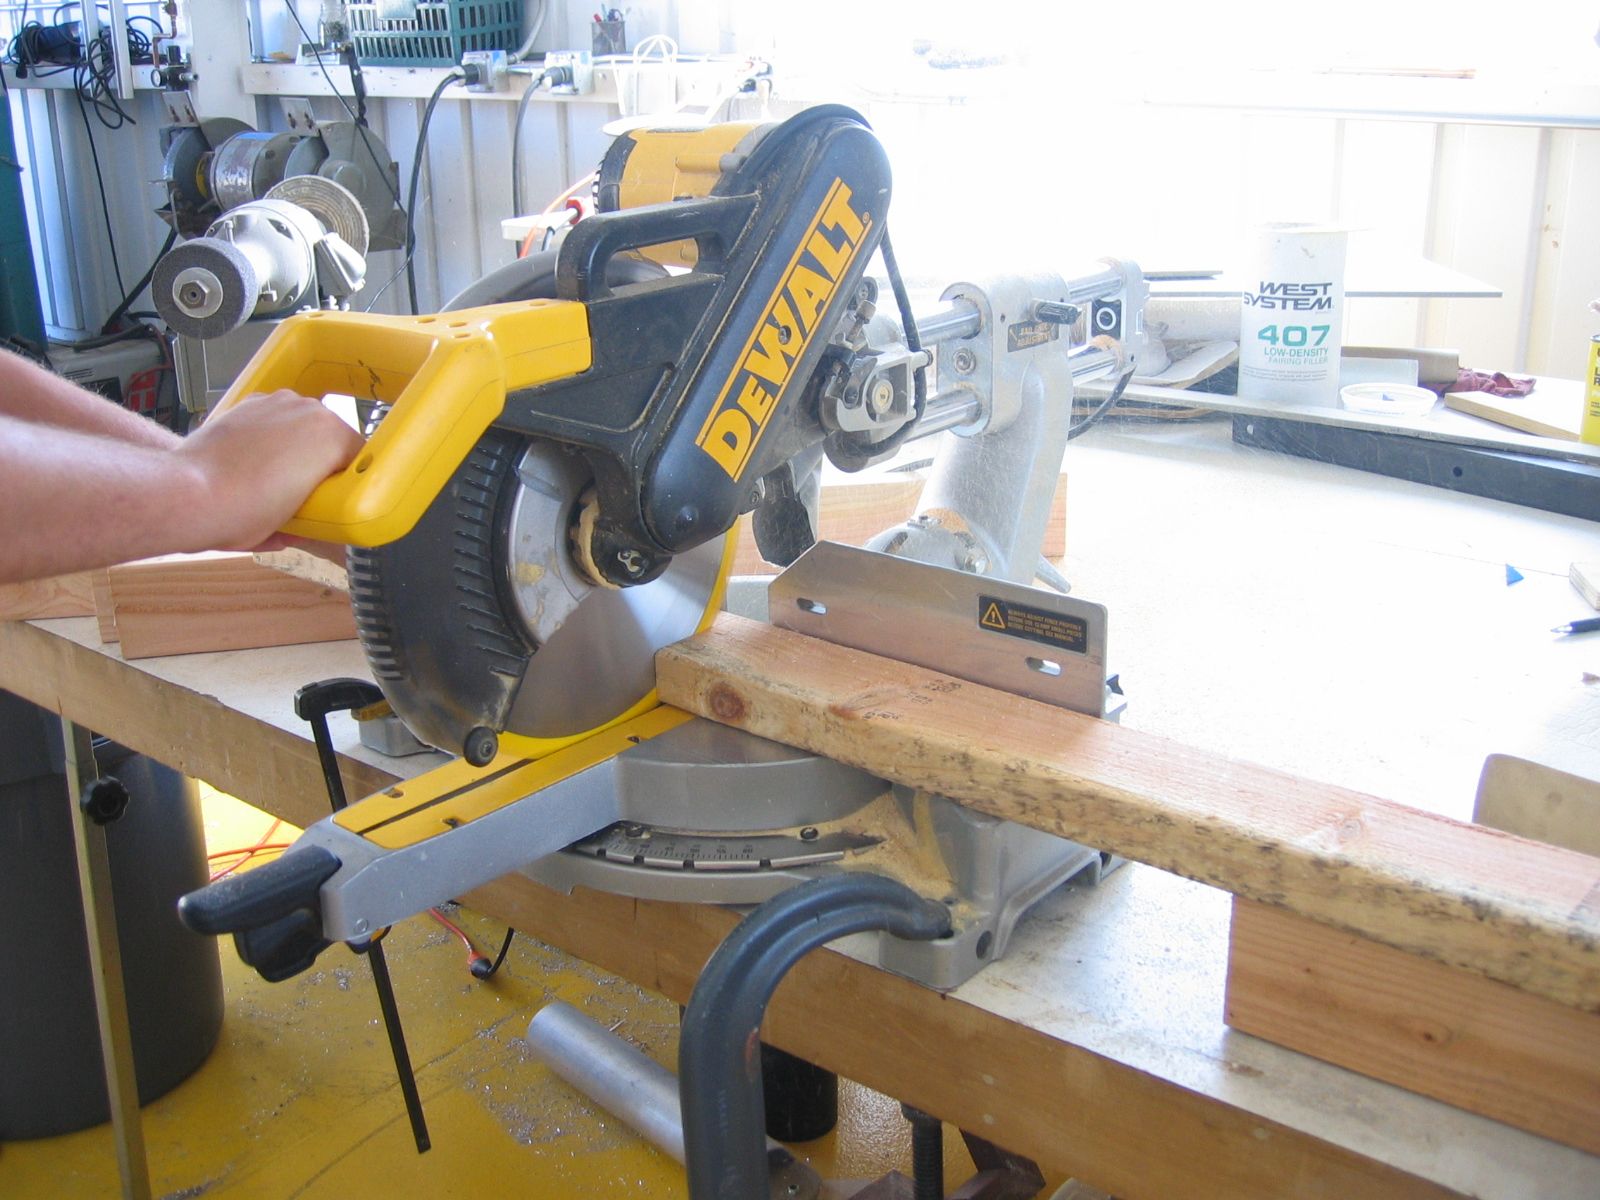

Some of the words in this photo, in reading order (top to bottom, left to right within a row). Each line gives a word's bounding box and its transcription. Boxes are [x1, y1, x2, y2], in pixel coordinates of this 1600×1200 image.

[1260, 281, 1333, 297] WEST
[701, 181, 865, 479] DEWALT
[1257, 324, 1331, 347] 407
[1264, 347, 1329, 358] LOW-DENSITY
